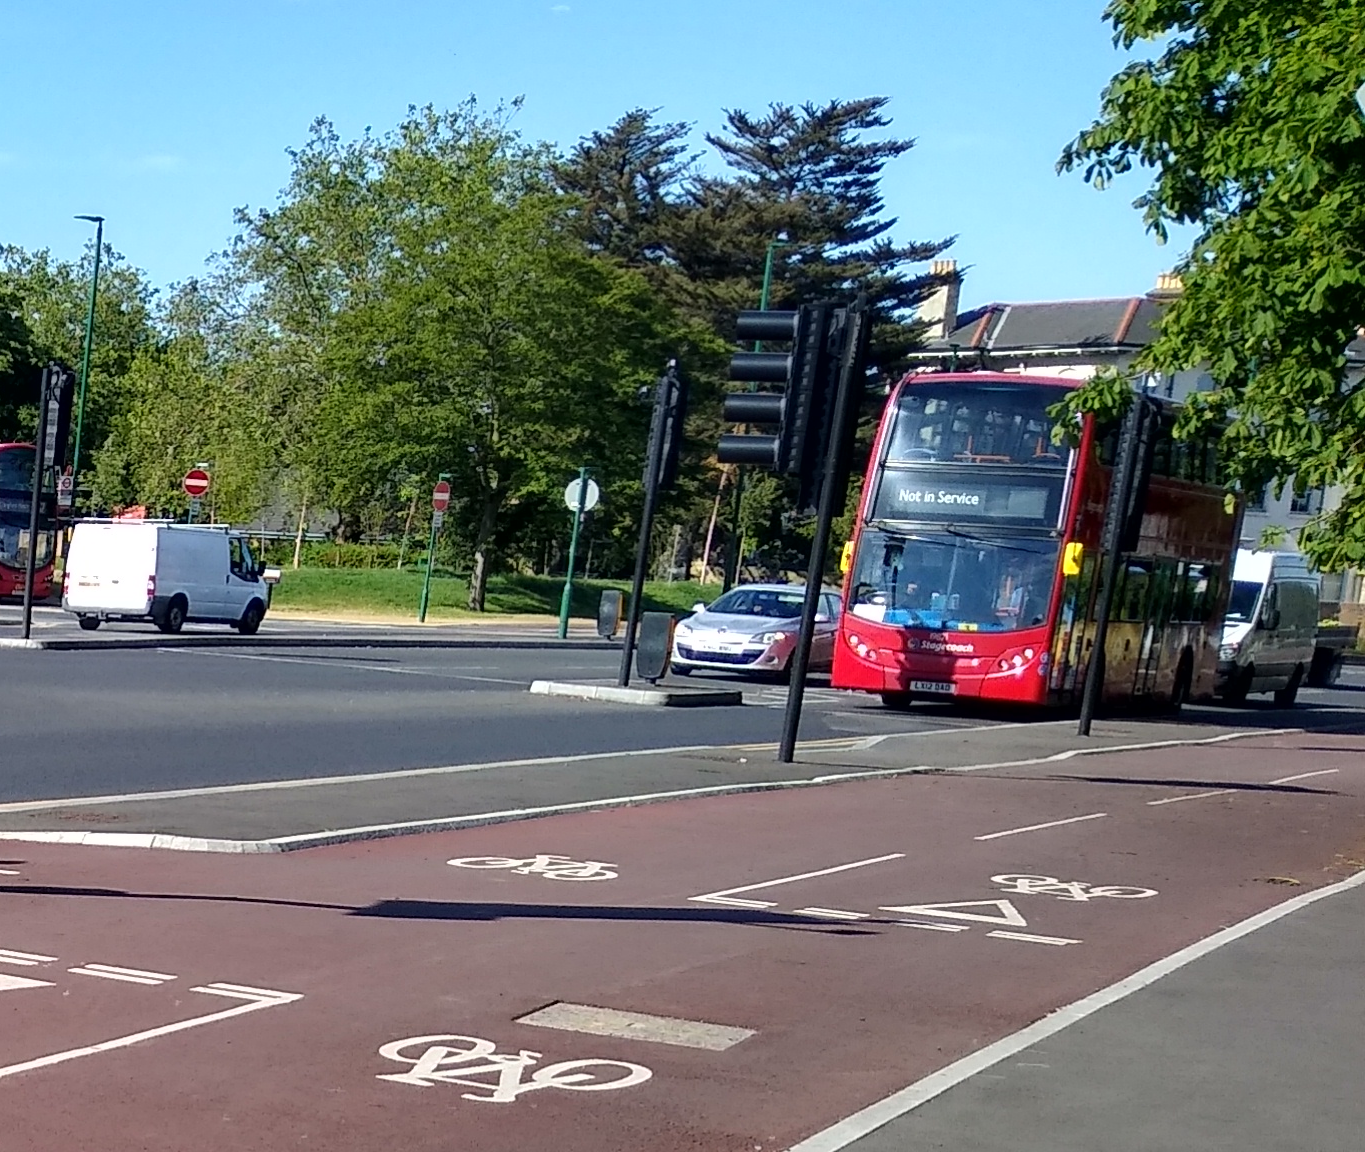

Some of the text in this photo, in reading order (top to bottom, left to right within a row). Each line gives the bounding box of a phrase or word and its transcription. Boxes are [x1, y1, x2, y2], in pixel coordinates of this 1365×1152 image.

[899, 488, 980, 505] Not in Service
[921, 640, 974, 652] Stagecoach
[914, 682, 933, 691] LX12
